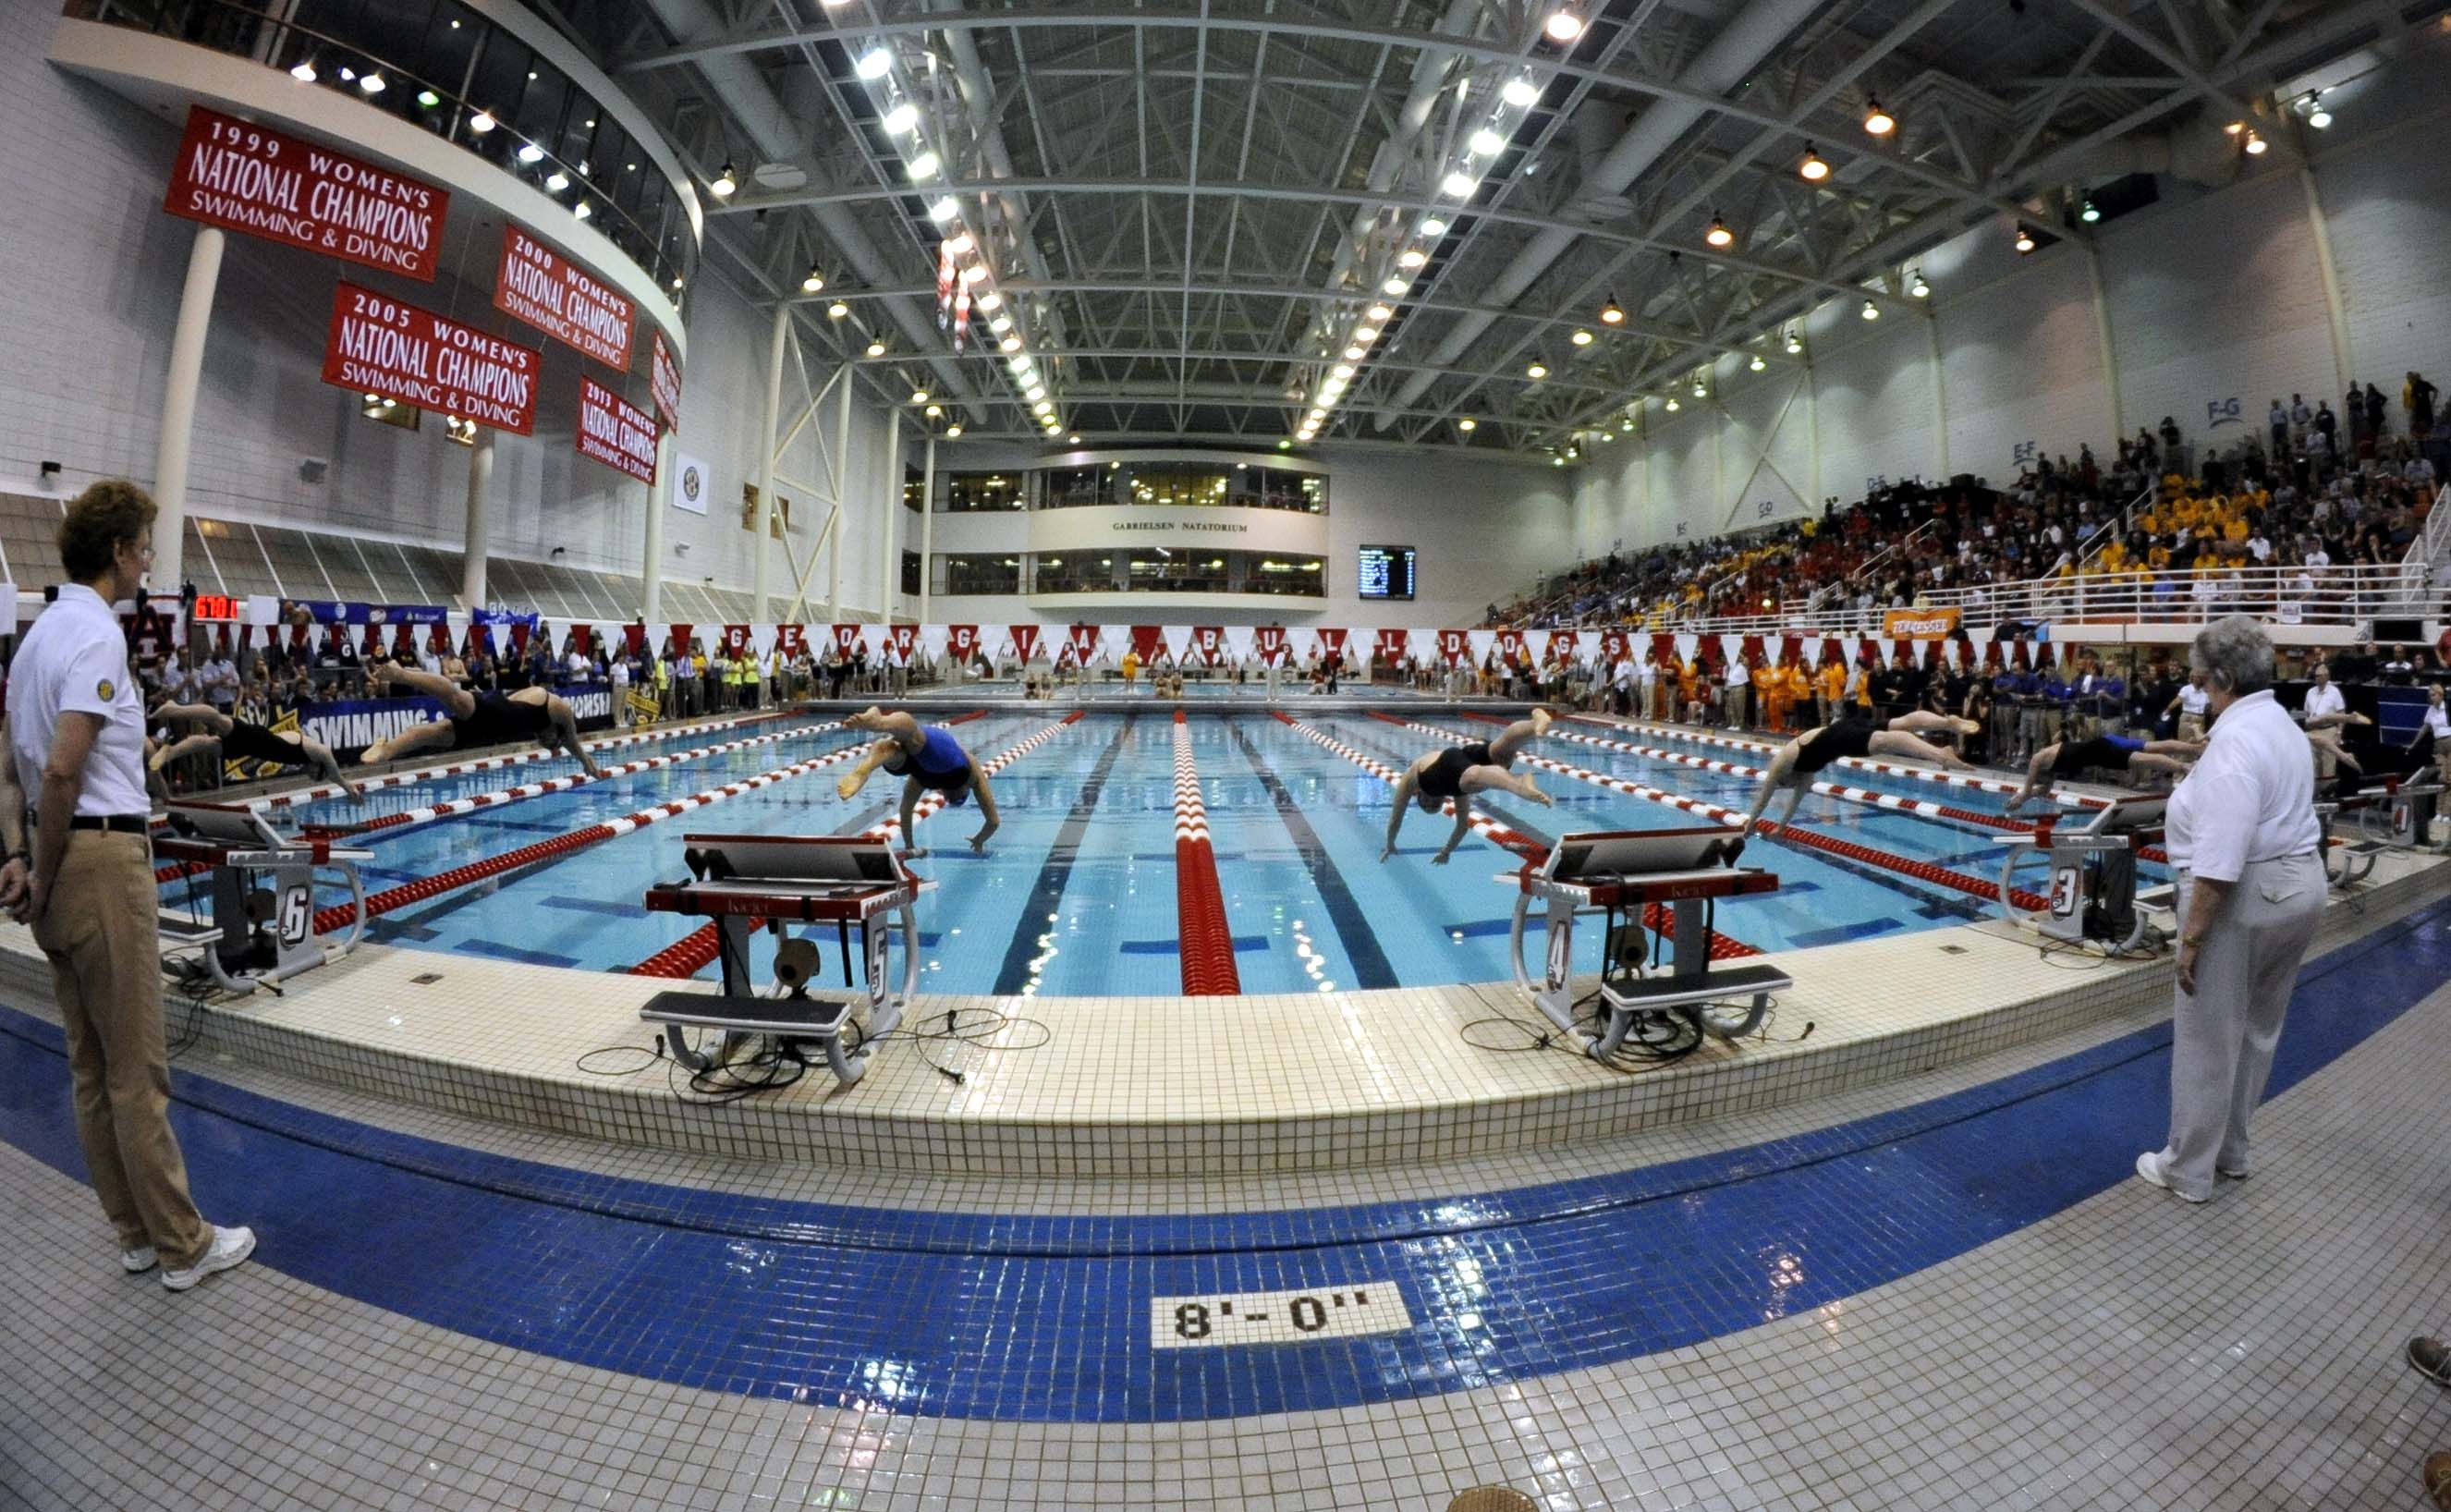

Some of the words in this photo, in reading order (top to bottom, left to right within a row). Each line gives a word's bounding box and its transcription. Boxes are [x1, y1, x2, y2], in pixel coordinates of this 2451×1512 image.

[189, 142, 302, 213] NATIONAL
[311, 181, 432, 250] CHAMPIONS
[212, 122, 280, 158] 1999
[310, 153, 430, 209] WOMEN'S
[190, 190, 315, 241] SWIMMING
[322, 229, 338, 248] &
[346, 235, 420, 271] DIVING
[504, 252, 564, 315] NATIONAL
[567, 290, 628, 349] CHAMPIONS
[515, 236, 553, 269] 2000
[567, 267, 627, 316] WOMEN'S
[338, 315, 429, 379] NATIONAL
[436, 348, 529, 408] CHAMPIONS
[354, 294, 410, 327] 2005
[433, 321, 528, 369] WOMEN'S
[505, 291, 570, 338] SWIMMING
[573, 329, 582, 344] &
[585, 335, 622, 365] DIVING
[341, 362, 441, 405] SWIMMING
[446, 392, 459, 410] &
[465, 396, 521, 427] DIVING
[618, 398, 656, 436] WOMEN'S
[582, 400, 618, 446] NATIONAL
[619, 421, 655, 466] CHAMPIONS
[582, 435, 623, 468] SWIMMING
[630, 459, 652, 482] DIVING
[1112, 521, 1176, 531] GABRIELSEN
[1182, 522, 1248, 533] NATATORIUM
[282, 885, 308, 942] 6
[2056, 867, 2078, 914] 3
